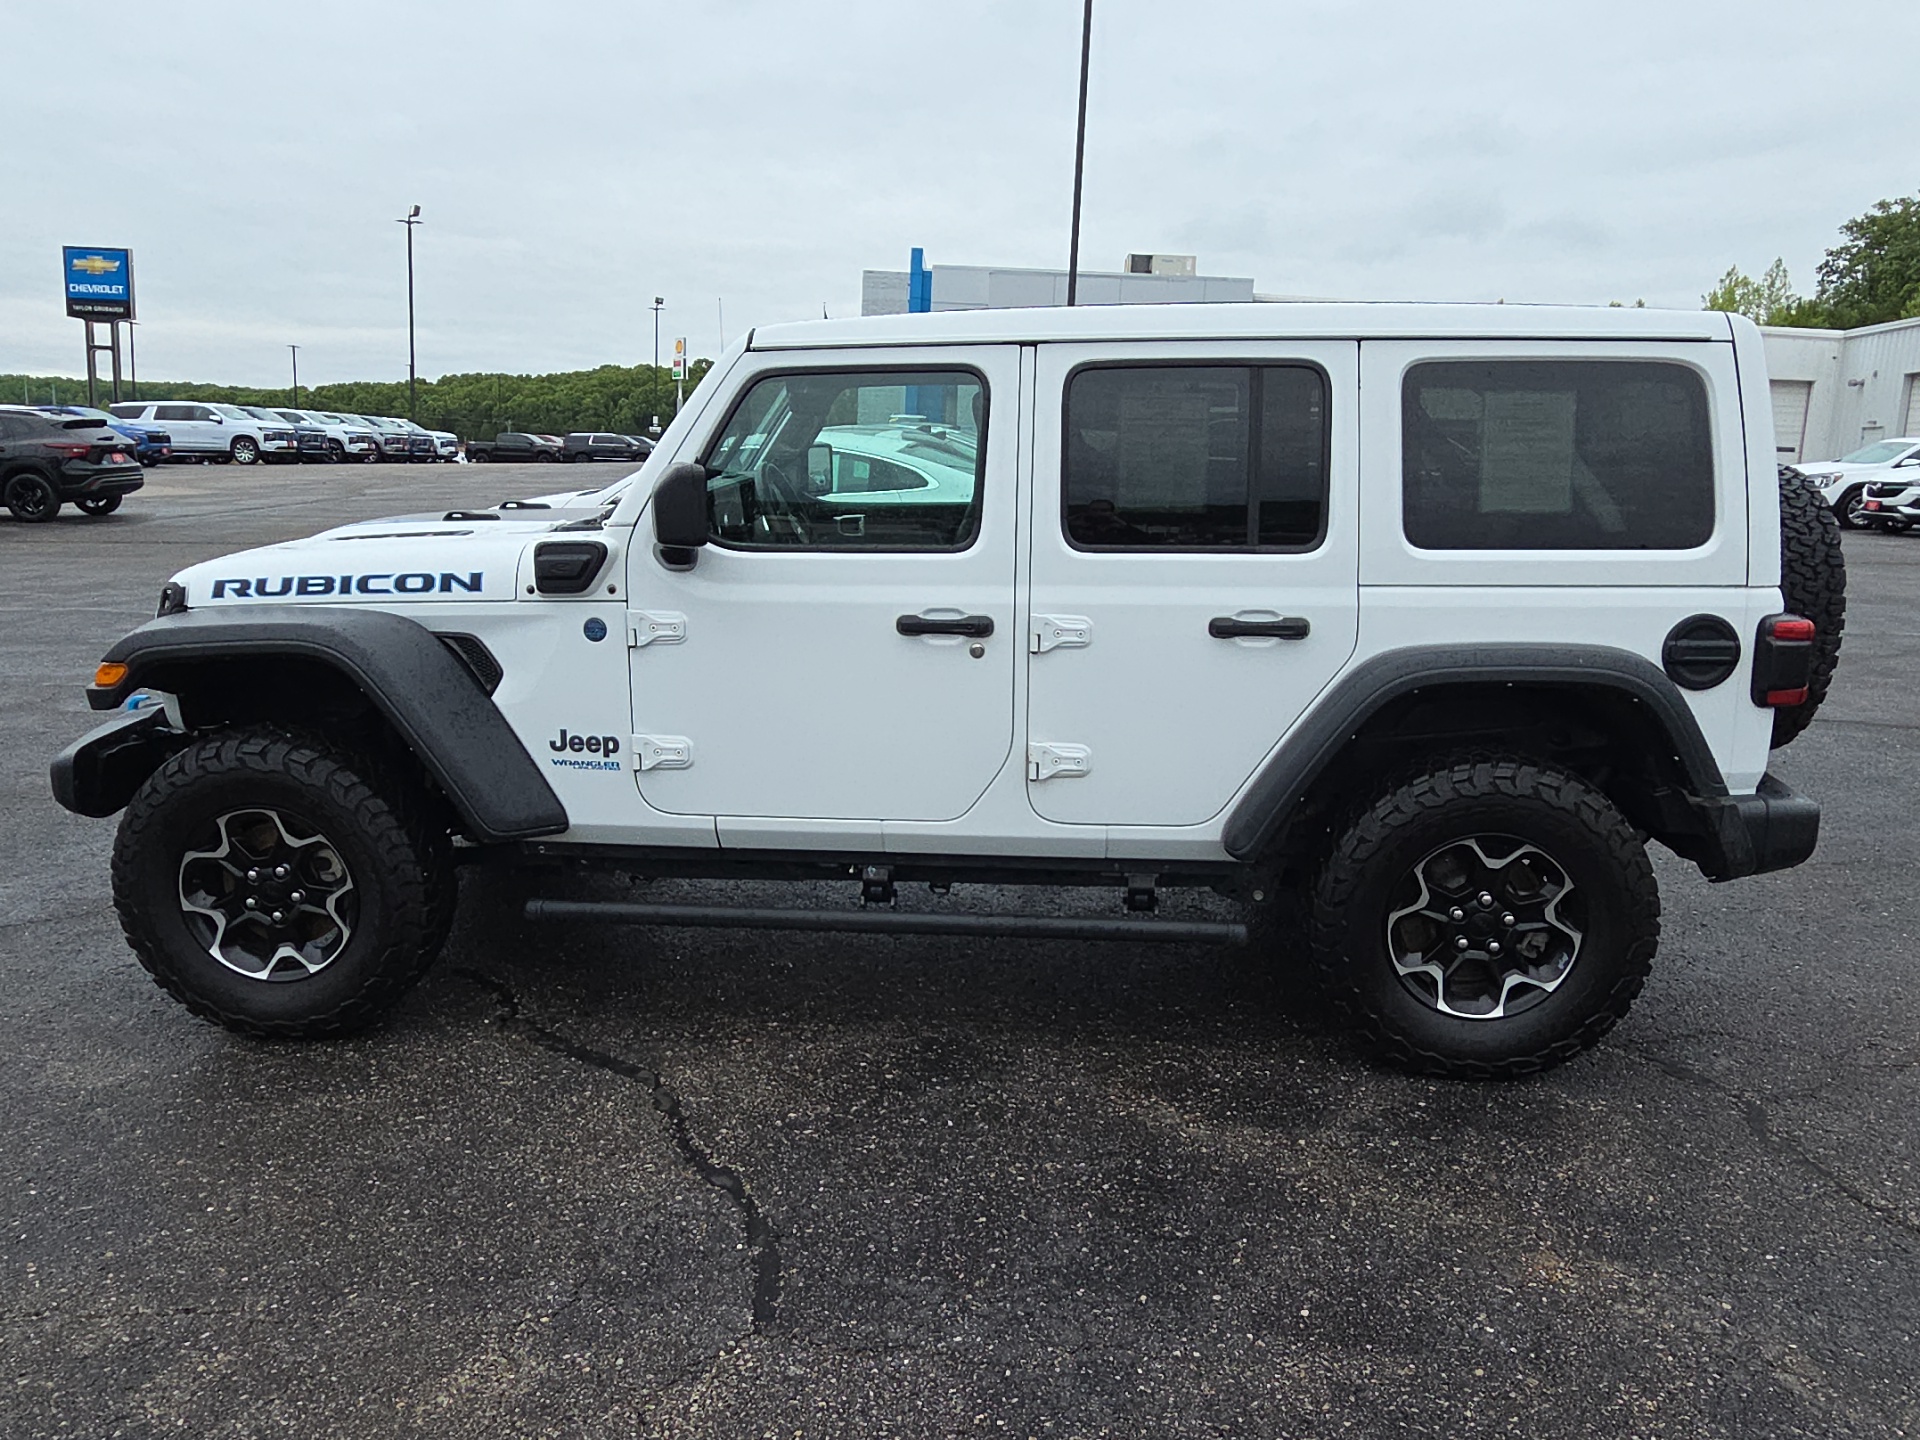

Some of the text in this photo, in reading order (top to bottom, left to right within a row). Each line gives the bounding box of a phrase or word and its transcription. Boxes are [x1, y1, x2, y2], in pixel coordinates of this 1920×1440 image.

[70, 283, 124, 294] CHEVROLET
[211, 571, 484, 599] RUBICON
[549, 728, 620, 758] Jeep
[551, 758, 620, 767] WRANGLER
